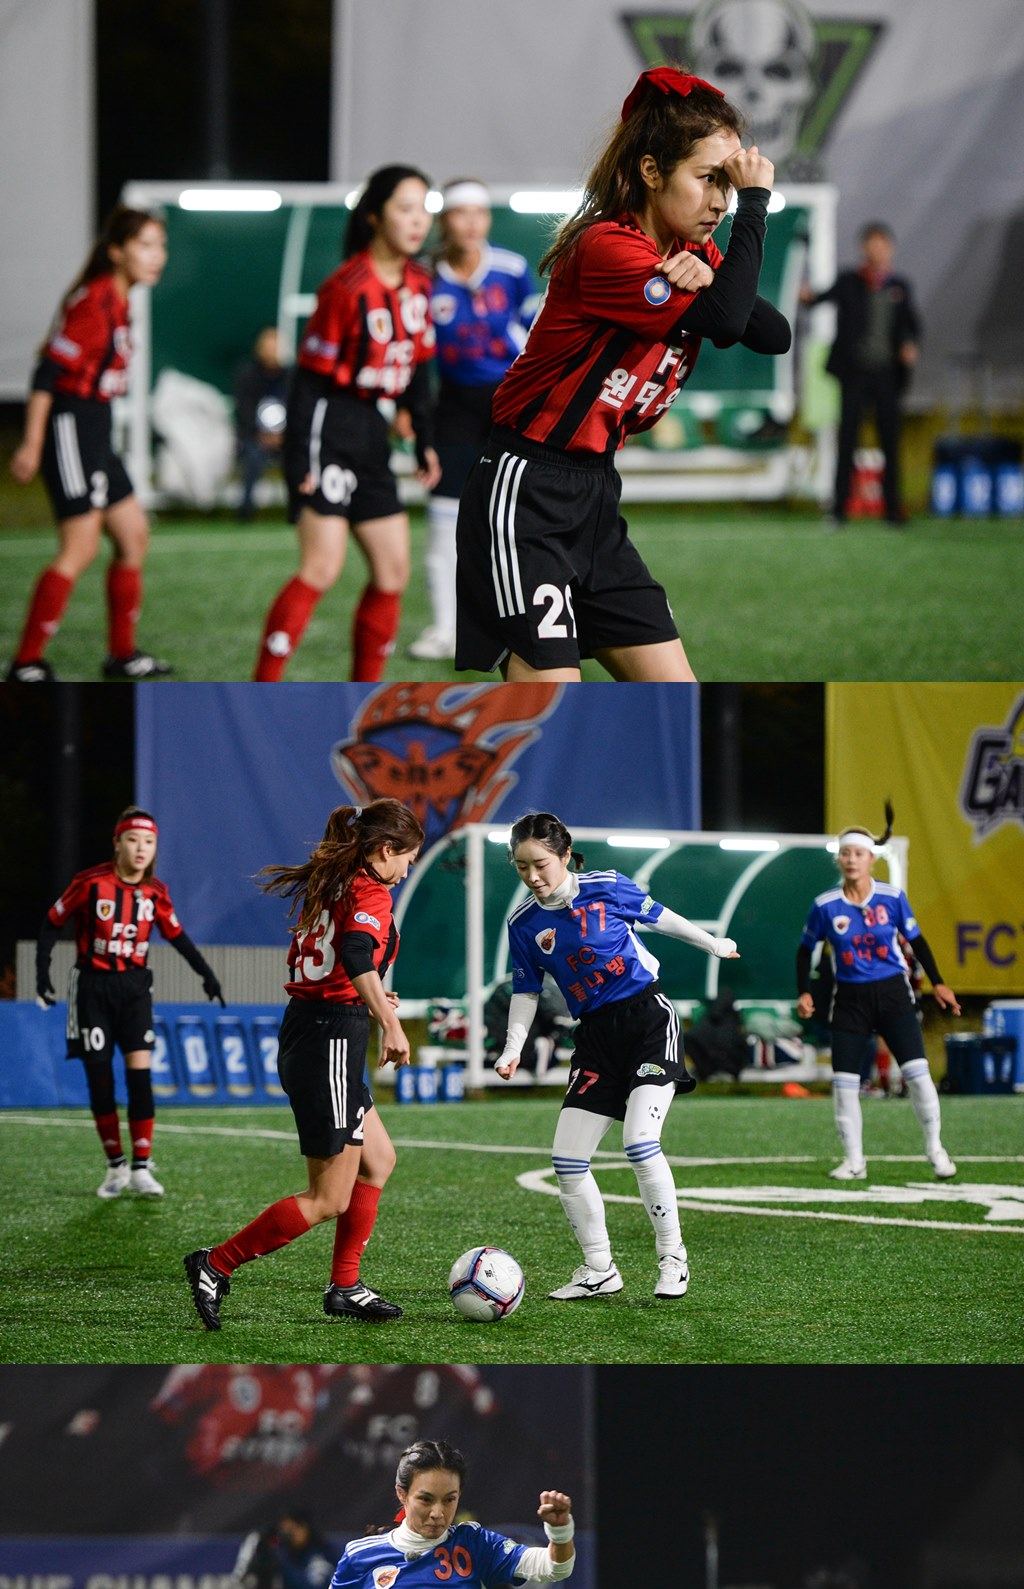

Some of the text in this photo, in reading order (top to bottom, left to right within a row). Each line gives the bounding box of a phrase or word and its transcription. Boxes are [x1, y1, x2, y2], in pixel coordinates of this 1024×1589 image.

[112, 922, 138, 939] FC
[570, 901, 607, 939] 77
[566, 947, 597, 973] FC
[82, 1025, 105, 1052] 10
[433, 1545, 474, 1581] 30
